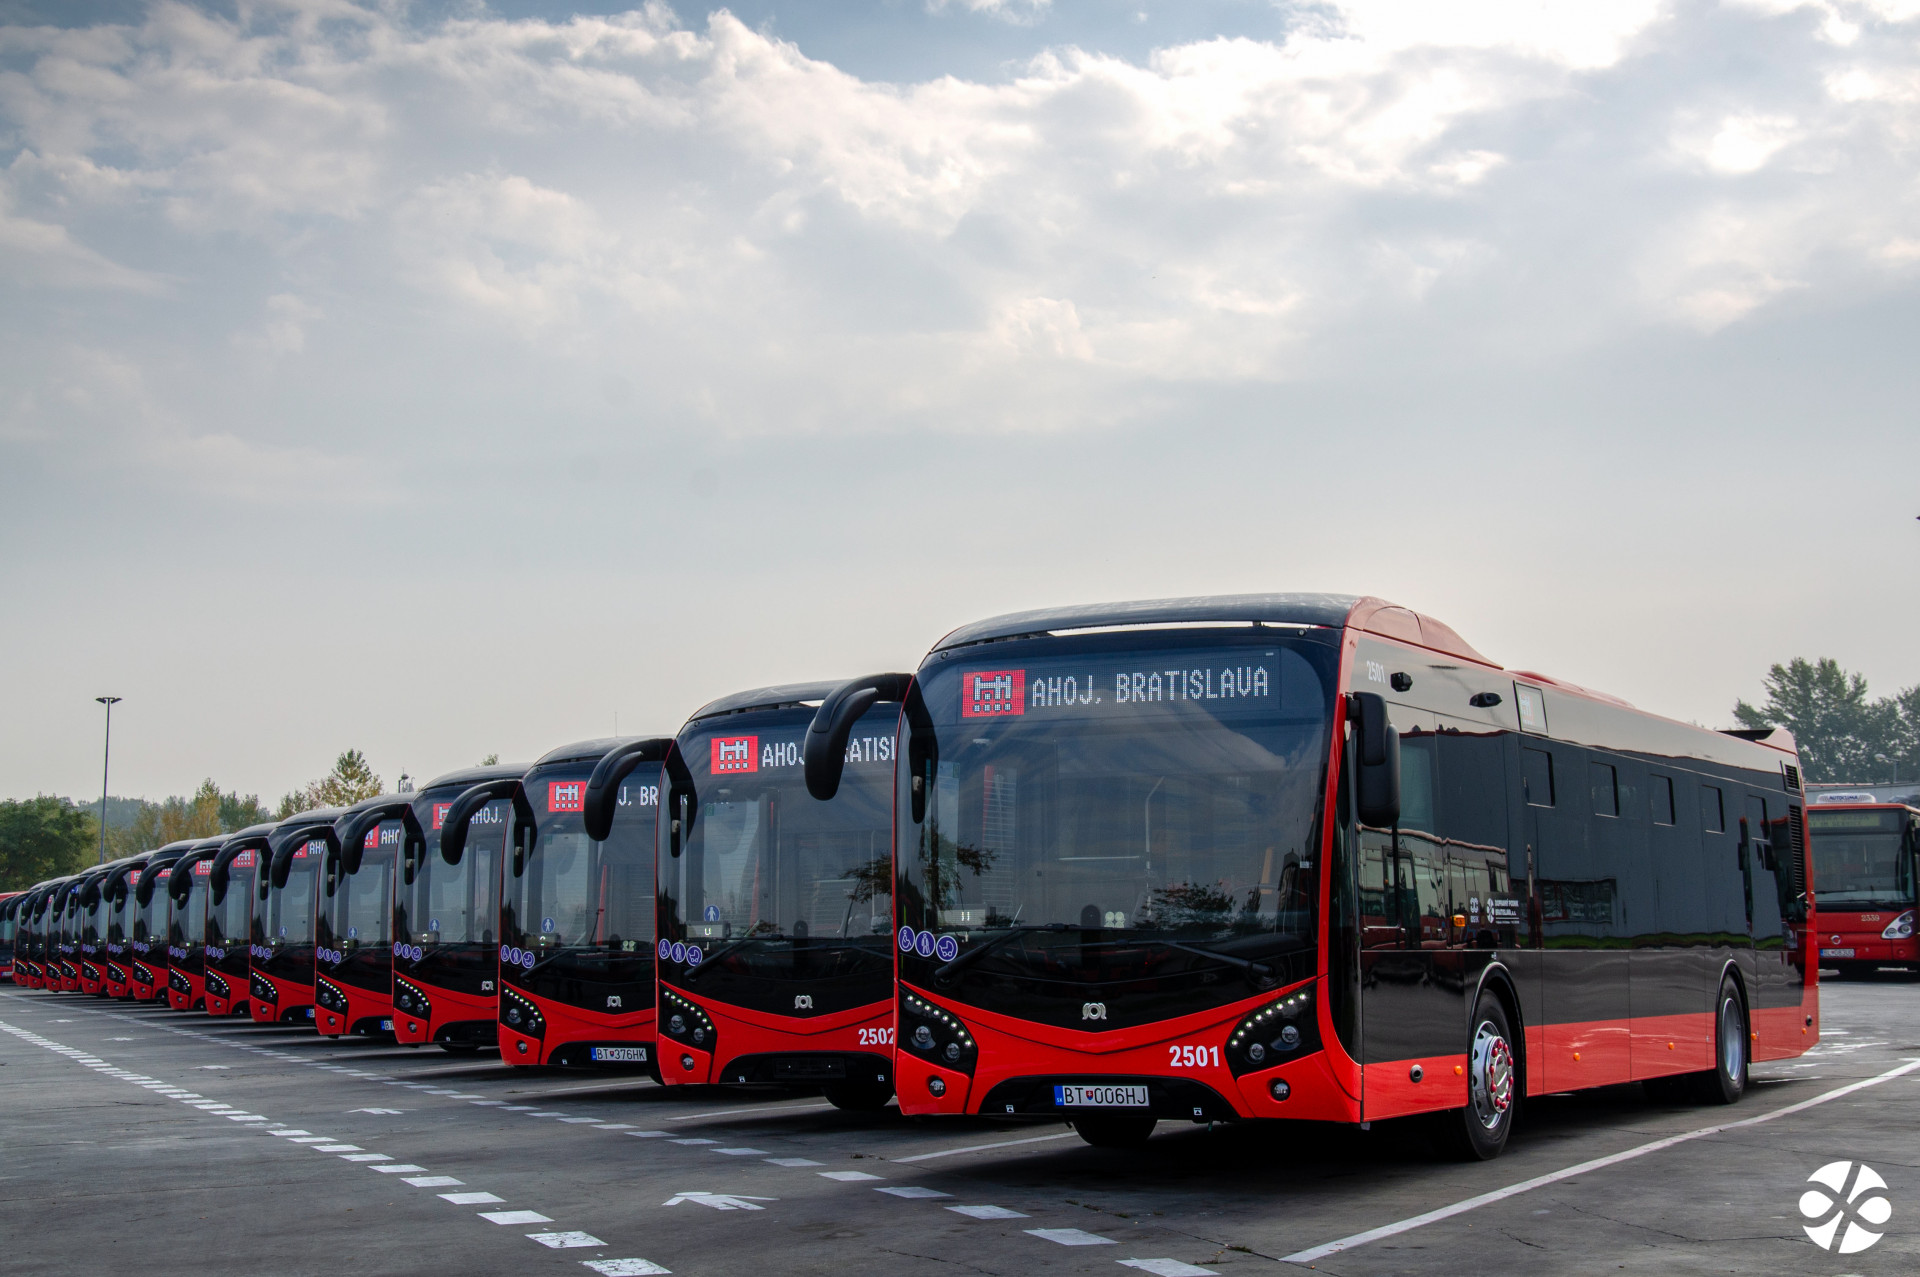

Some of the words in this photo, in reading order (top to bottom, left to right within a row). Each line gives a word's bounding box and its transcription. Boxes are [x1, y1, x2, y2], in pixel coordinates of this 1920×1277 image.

[1366, 660, 1386, 684] 2501
[1032, 675, 1101, 707] AHOJ,
[1116, 666, 1268, 703] BRATISLAVA
[858, 1027, 894, 1045] 2502
[1168, 1045, 1220, 1067] 2501
